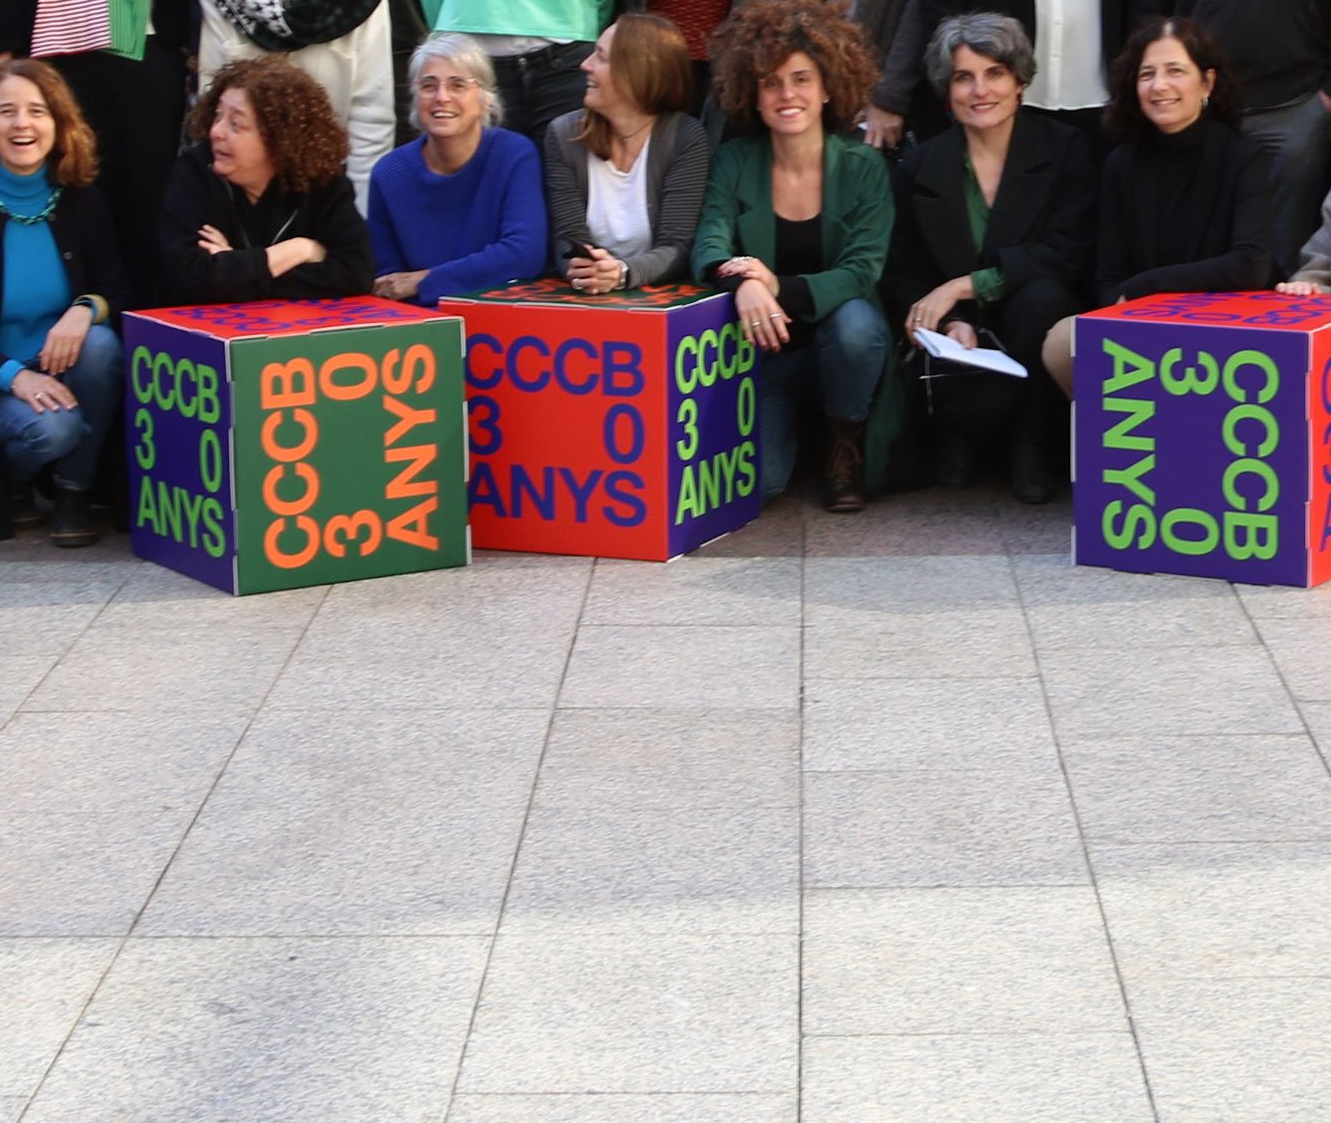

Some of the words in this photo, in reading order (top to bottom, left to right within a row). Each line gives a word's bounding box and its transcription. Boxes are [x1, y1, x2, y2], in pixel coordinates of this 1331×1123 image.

[131, 346, 220, 424] CCCB
[318, 352, 378, 401] 0
[469, 333, 645, 397] CCCB
[675, 326, 755, 395] CCCB
[1159, 348, 1220, 396] 3
[133, 408, 156, 469] 3
[199, 431, 223, 494] 0
[381, 344, 439, 551] ANYS
[470, 395, 503, 454] 3
[604, 403, 644, 465] 0
[676, 399, 699, 461] 3
[737, 376, 755, 437] 0
[1102, 338, 1157, 550] ANYS
[1222, 349, 1280, 560] CCCB
[261, 356, 321, 569] CCCB
[468, 467, 647, 527] ANYS
[675, 441, 756, 525] ANYS
[137, 481, 224, 558] ANYS
[323, 508, 382, 558] 3
[1160, 507, 1220, 556] 0
